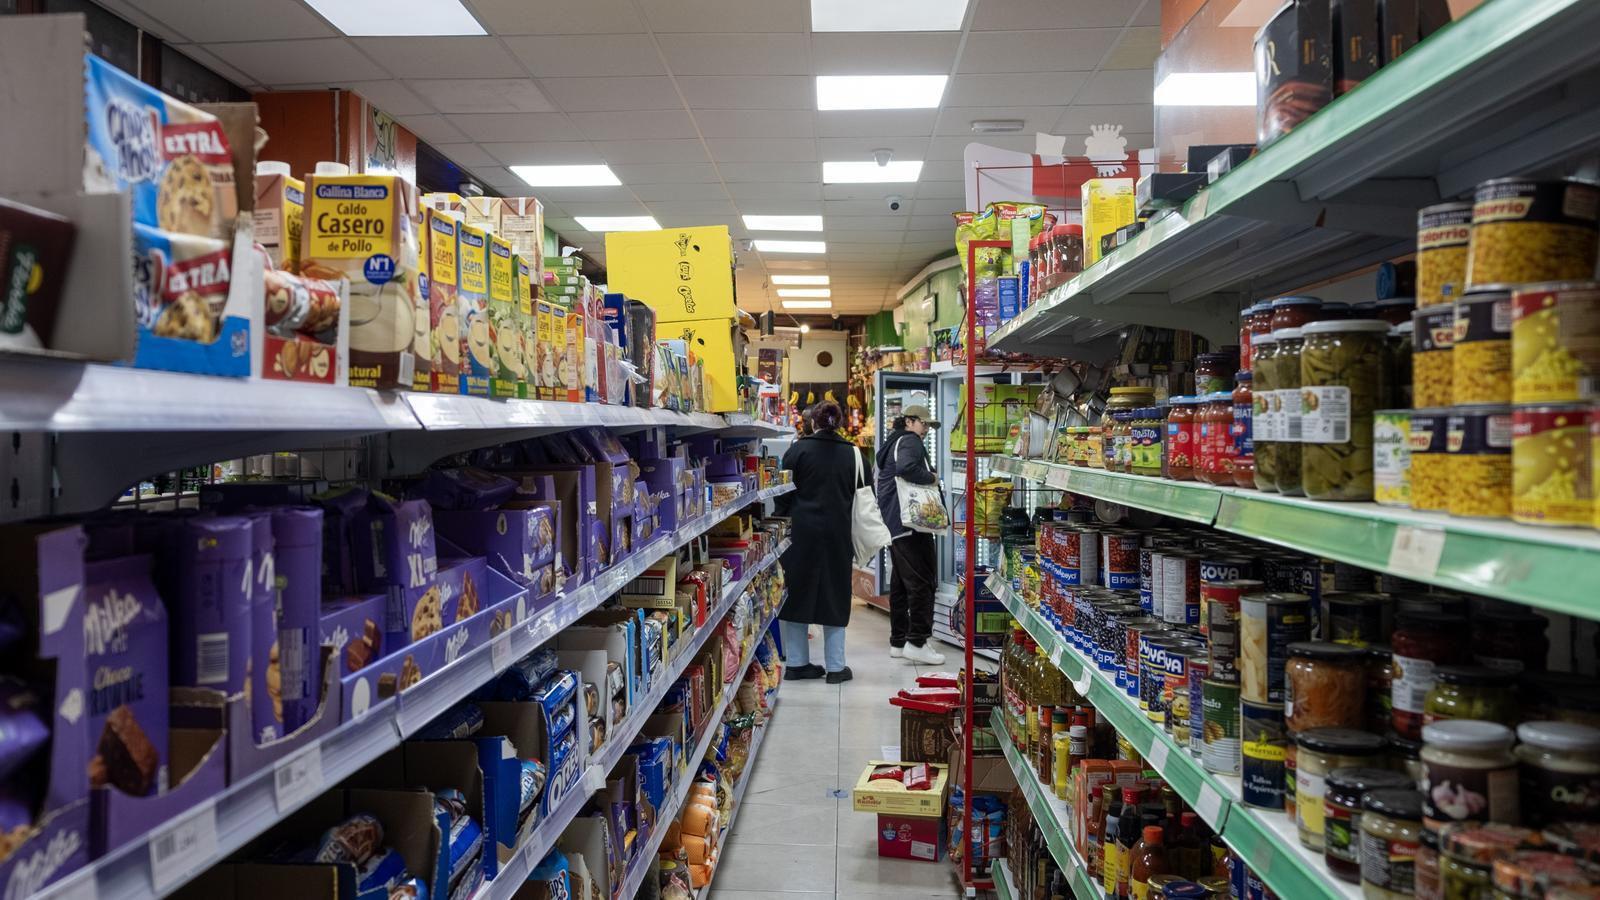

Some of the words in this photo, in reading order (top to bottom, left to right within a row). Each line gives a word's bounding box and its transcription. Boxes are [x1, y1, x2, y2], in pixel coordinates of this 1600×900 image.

[165, 130, 226, 154] EXTRA
[318, 186, 353, 198] Gallina
[354, 186, 385, 199] Blanca
[337, 202, 367, 215] Caldo
[317, 214, 384, 234] Casero
[328, 241, 339, 251] de
[342, 239, 372, 252] Pollo
[677, 286, 696, 313] Cheetos
[407, 553, 426, 588] XL
[1201, 567, 1239, 579] GOYA
[83, 589, 142, 656] Milka
